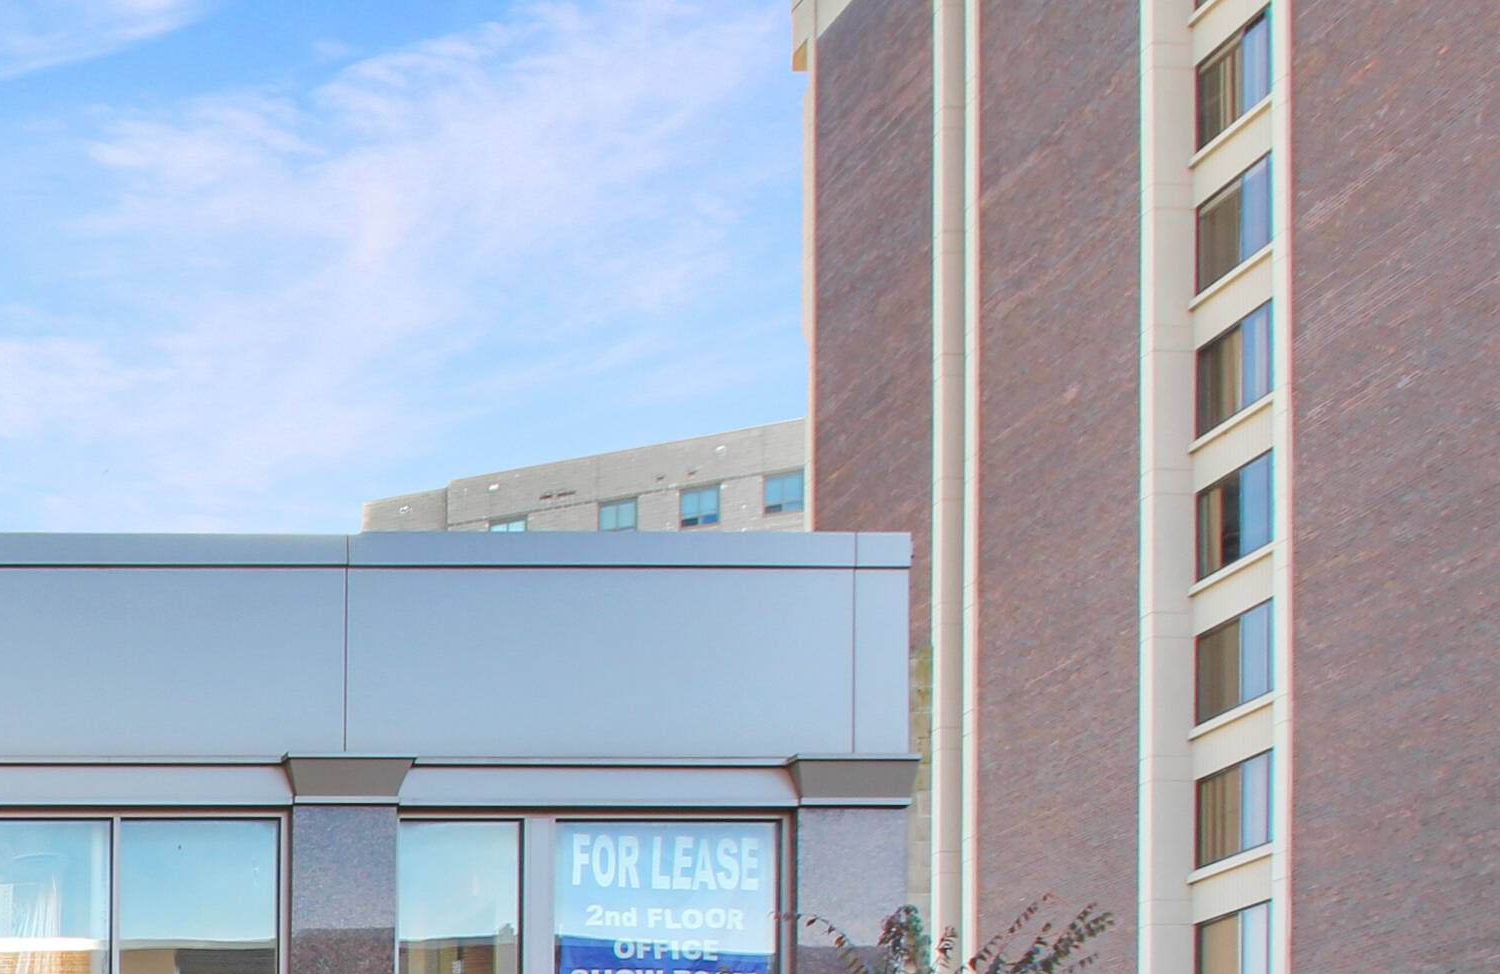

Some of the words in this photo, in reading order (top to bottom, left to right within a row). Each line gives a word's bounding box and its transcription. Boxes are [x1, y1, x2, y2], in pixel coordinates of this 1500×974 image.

[571, 833, 640, 889] FOR
[651, 835, 760, 891] LEASE
[585, 904, 637, 928] 2nd
[647, 907, 744, 930] FLOOR
[612, 937, 720, 962] OFFICE
